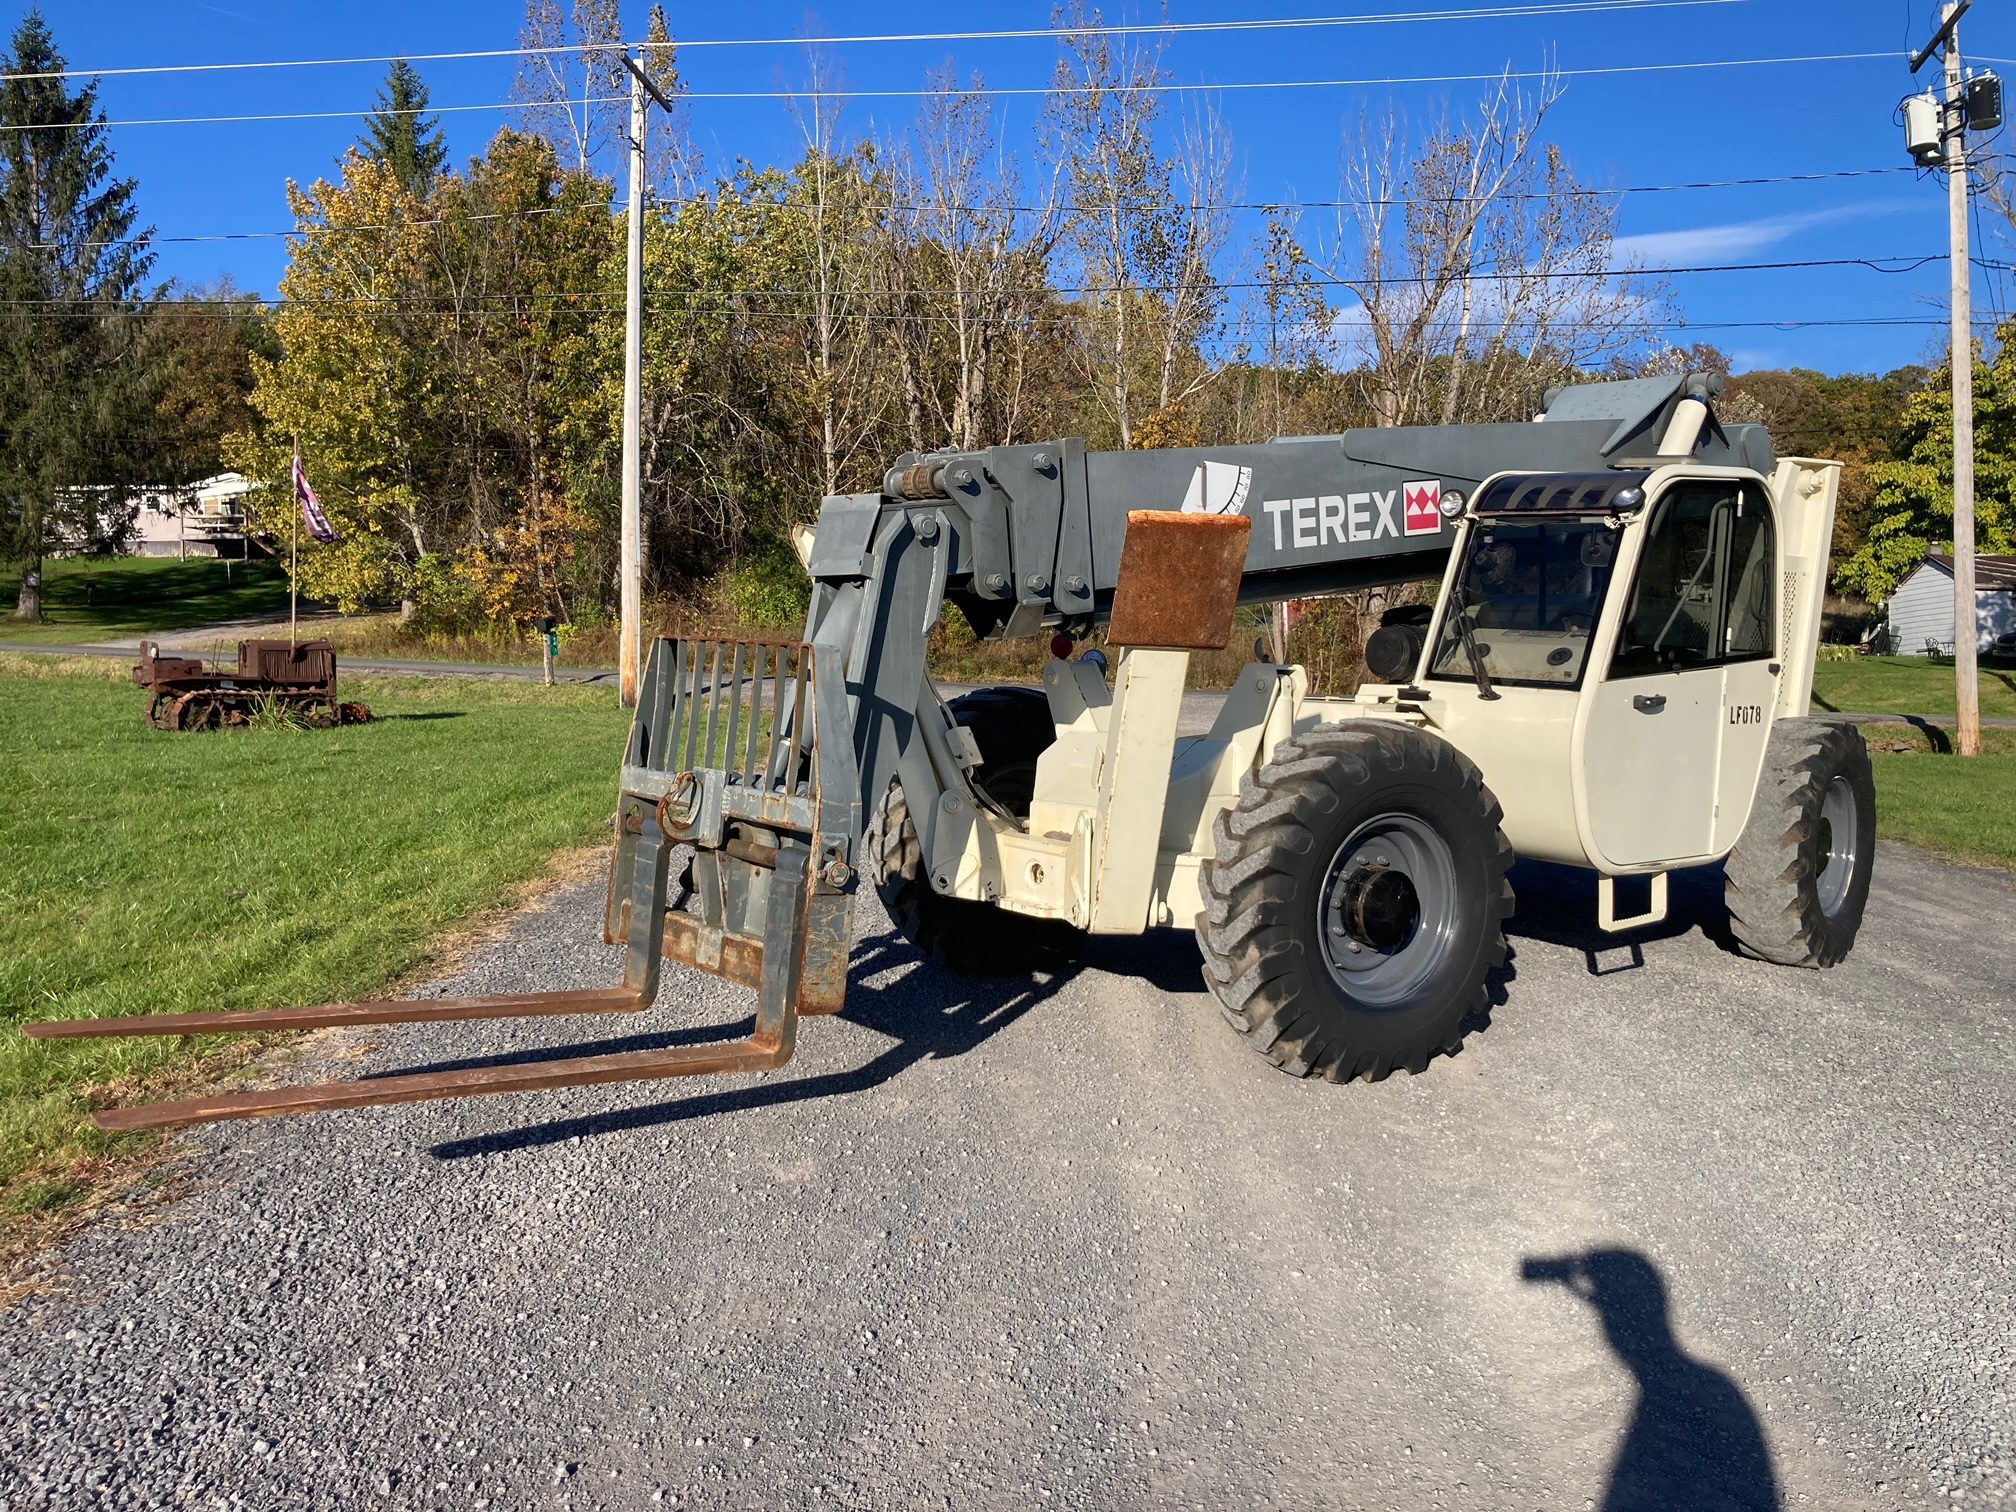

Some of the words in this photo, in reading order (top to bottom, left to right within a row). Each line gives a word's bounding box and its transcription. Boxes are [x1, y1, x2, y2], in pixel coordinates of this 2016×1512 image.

[1243, 483, 1249, 491] 70
[1240, 494, 1246, 504] 60
[1263, 490, 1399, 550] TEREX
[1730, 705, 1762, 724] LF078
